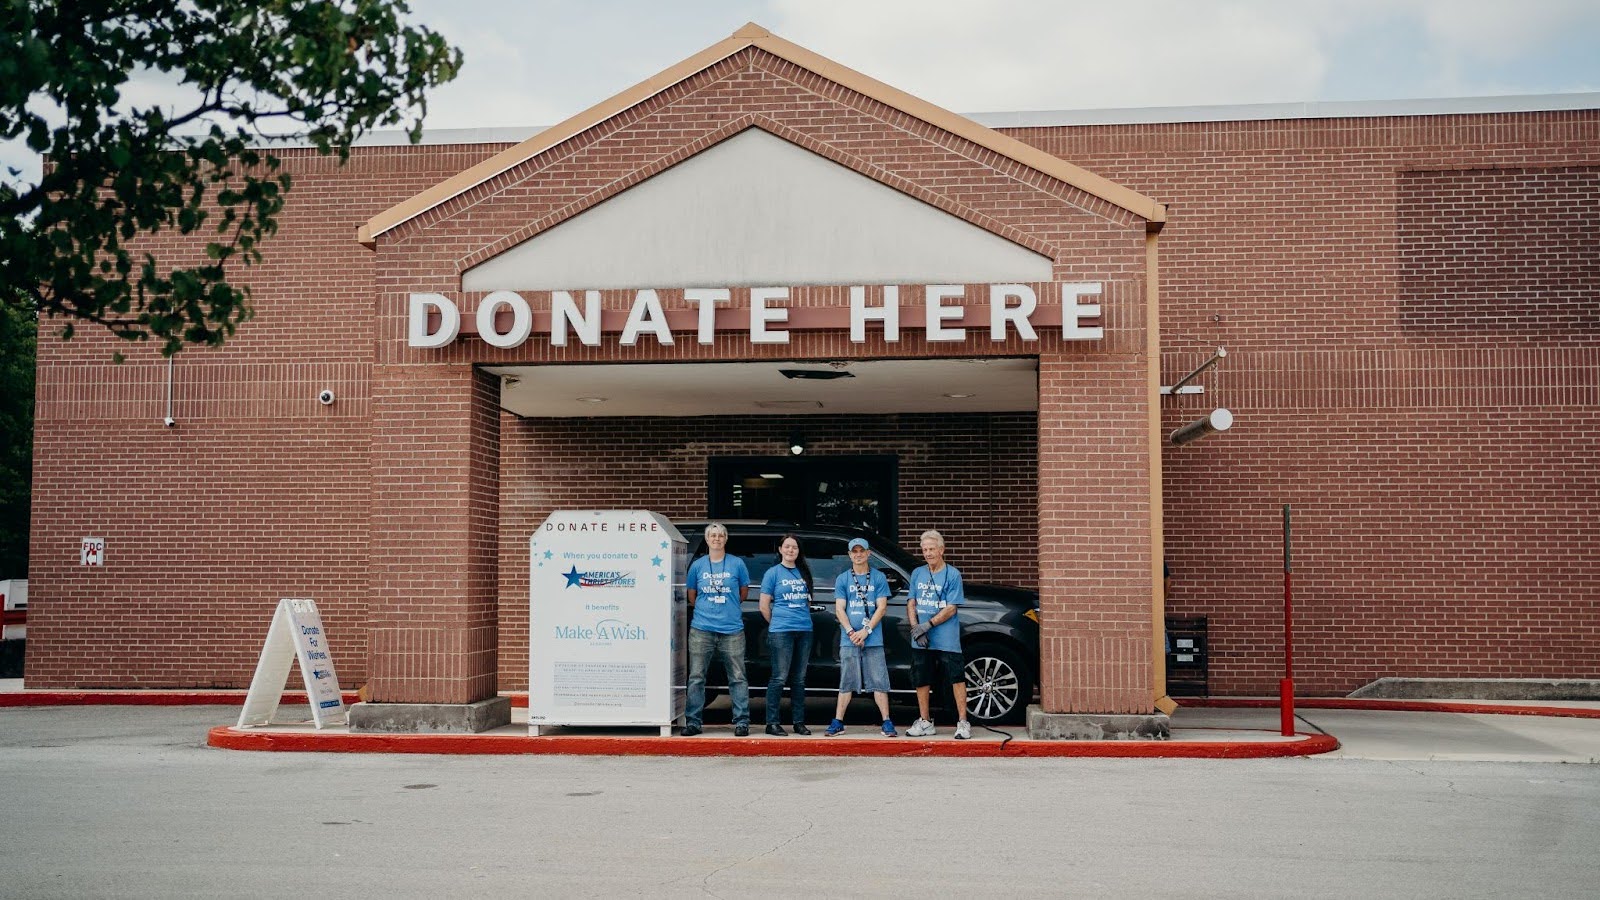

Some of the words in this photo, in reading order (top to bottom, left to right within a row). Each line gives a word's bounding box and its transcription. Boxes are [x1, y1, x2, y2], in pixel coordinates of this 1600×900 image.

[408, 287, 790, 348] DONATE
[850, 282, 1105, 343] HERE
[546, 523, 608, 532] DONATE
[618, 522, 658, 532] HERE
[83, 542, 102, 551] FDC
[602, 552, 629, 560] donate
[630, 552, 638, 560] to
[584, 571, 621, 579] AMERICA'S
[702, 572, 730, 580] Donate
[610, 578, 636, 586] STORES
[917, 582, 942, 591] Donate
[921, 590, 935, 599] For
[301, 625, 320, 635] Donate
[554, 625, 593, 640] Make
[612, 625, 646, 640] Wish
[309, 637, 318, 648] For
